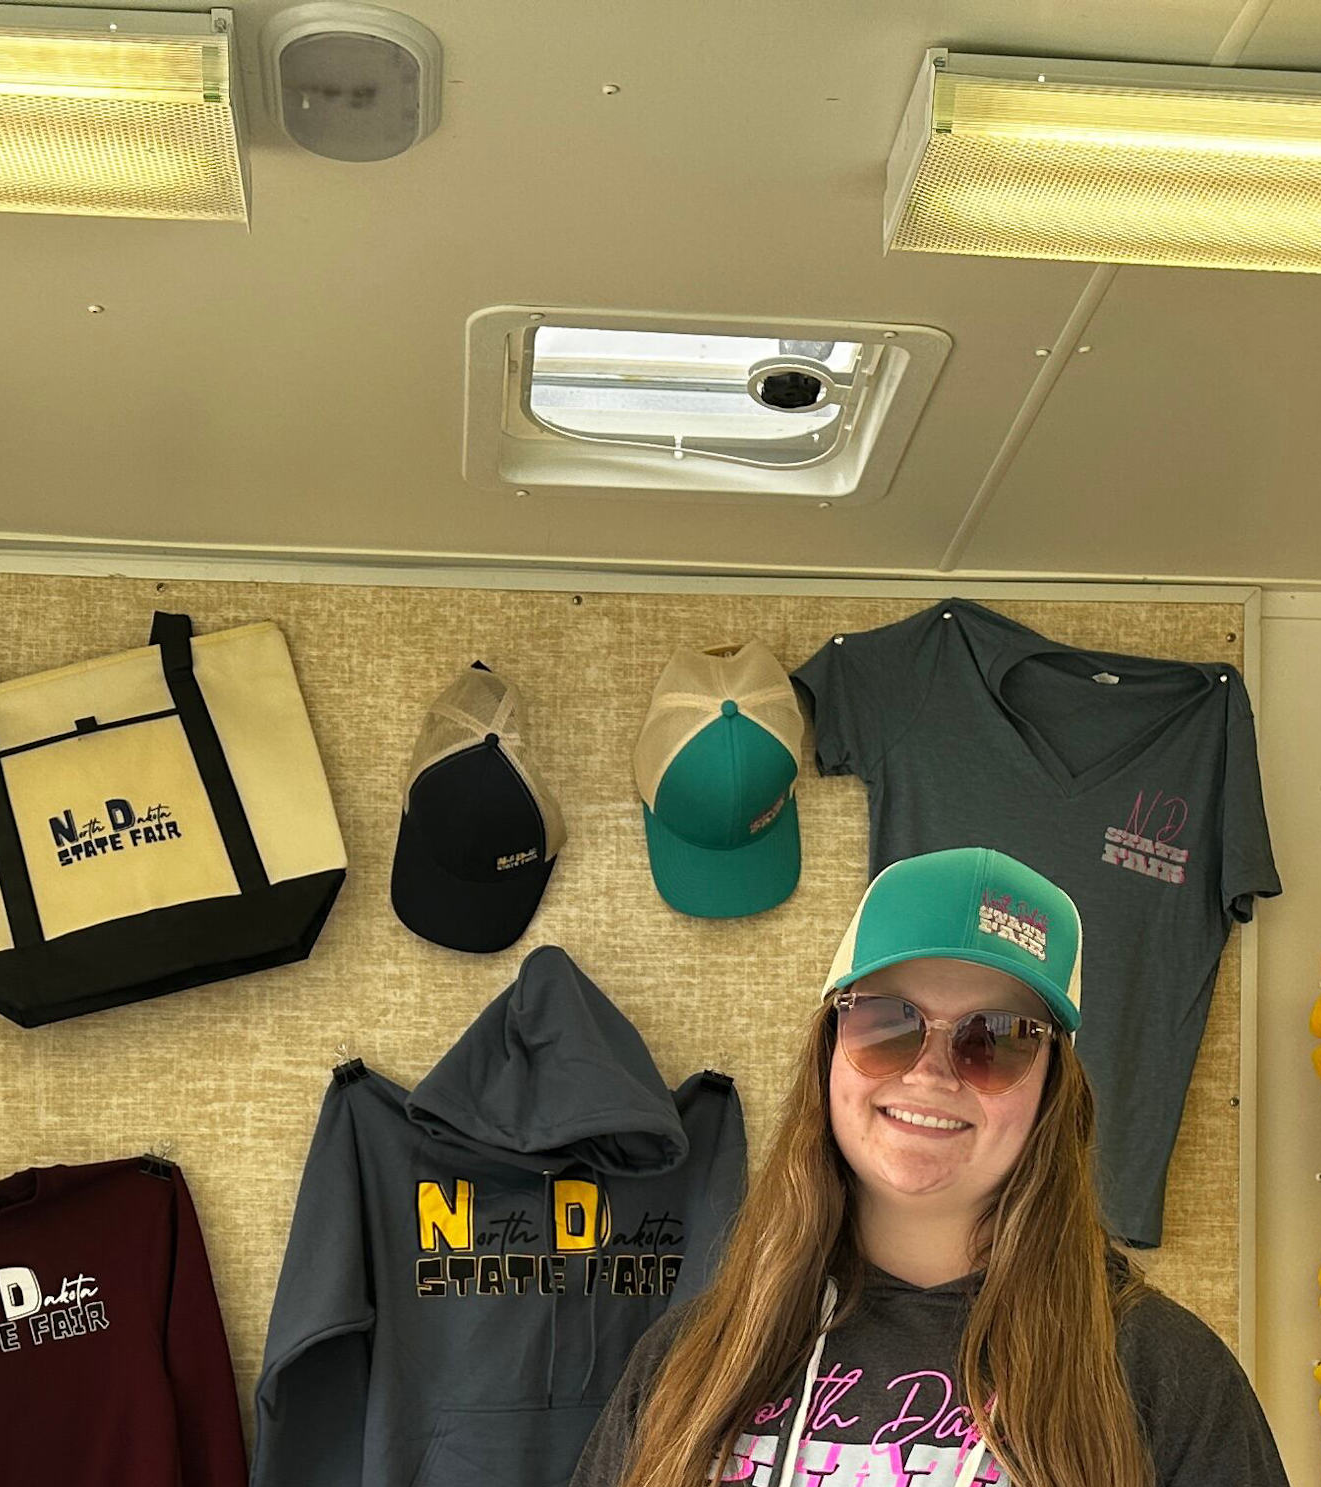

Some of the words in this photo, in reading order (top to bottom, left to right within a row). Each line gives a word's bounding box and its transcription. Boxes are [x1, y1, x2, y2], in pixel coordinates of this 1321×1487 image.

[49, 808, 106, 849] North
[104, 798, 173, 833] Dakota
[57, 833, 125, 867] STATE
[129, 820, 182, 847] FAIR
[416, 1177, 540, 1256] North
[552, 1178, 685, 1256] Dakota
[416, 1254, 567, 1298] STATE
[584, 1253, 685, 1298] FAIR
[29, 1300, 110, 1346] FAIR
